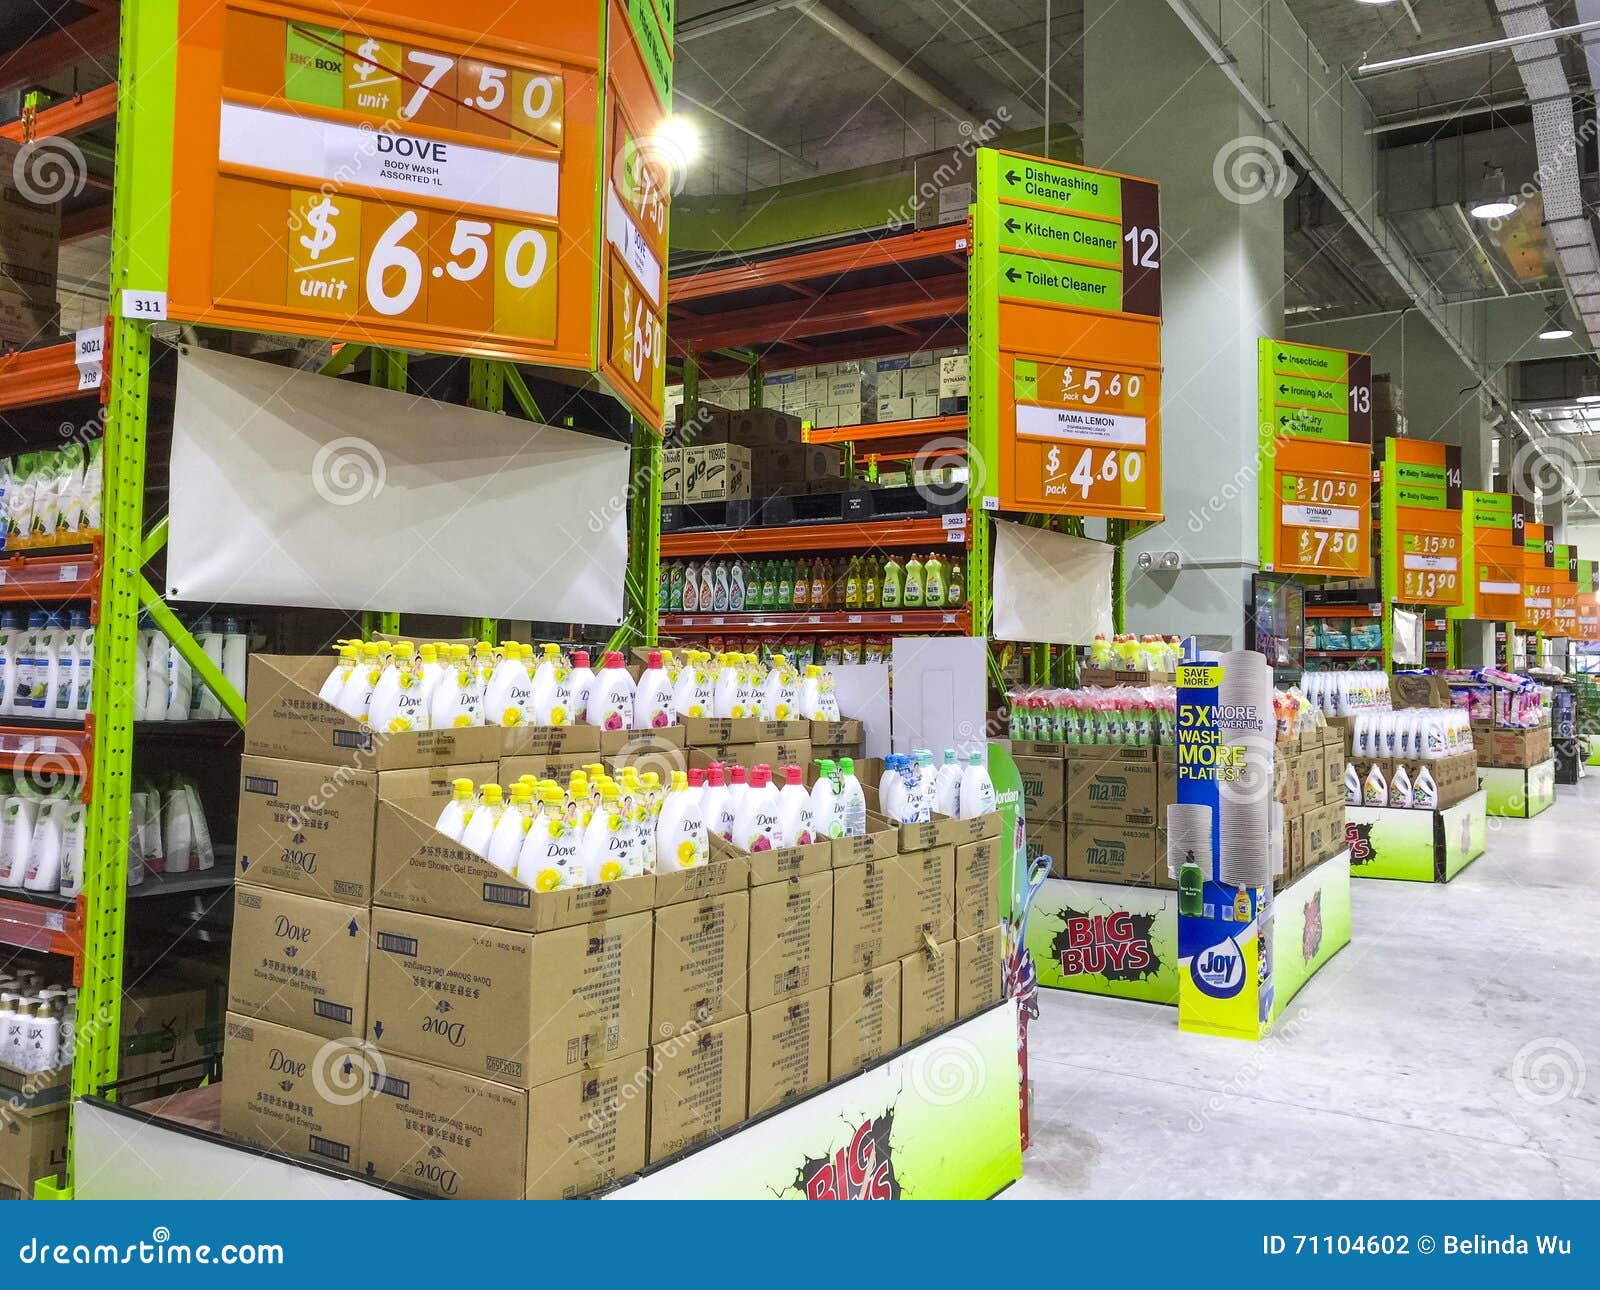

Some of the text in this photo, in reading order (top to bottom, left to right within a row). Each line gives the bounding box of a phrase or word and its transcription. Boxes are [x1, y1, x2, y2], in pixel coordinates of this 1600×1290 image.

[315, 57, 342, 73] BOX
[358, 90, 390, 110] unit
[376, 133, 448, 164] DOVE
[384, 159, 440, 176] BODY WASH
[380, 169, 443, 186] ASSORTED 1L
[1025, 167, 1098, 196] Dishwashing
[1025, 183, 1071, 202] Cleaner
[1025, 222, 1117, 249] Kitchen Cleaner
[1124, 225, 1160, 269] 12
[299, 276, 349, 302] unit
[1026, 271, 1107, 294] Toilet Cleaner
[135, 299, 161, 312] 311
[81, 340, 101, 355] 9021
[1289, 355, 1328, 368] Insecticide
[84, 371, 97, 384] 108
[943, 376, 967, 384] DYNAMO
[1063, 392, 1079, 401] pack
[1291, 386, 1333, 399] Ironing Aids
[1349, 385, 1370, 413] 13
[1058, 414, 1115, 427] MAMA LEMON
[1446, 468, 1462, 489] 14
[1045, 483, 1067, 496] pack
[1306, 507, 1332, 516] DYNAMO
[1512, 513, 1524, 529] 15
[1544, 540, 1554, 553] 16
[1569, 558, 1577, 570] 17
[1184, 669, 1208, 677] SAVE
[460, 694, 480, 705] Dove
[511, 687, 531, 699] Dove
[399, 695, 422, 708] Dove
[1179, 705, 1257, 727] 5X MORE
[1179, 730, 1222, 744] WASH
[1179, 745, 1247, 767] MORE
[684, 819, 702, 832] Dove
[756, 814, 778, 826] Dove
[547, 844, 576, 857] Dove
[609, 837, 635, 850] Dove
[281, 849, 317, 874] Dove
[410, 858, 498, 879] Dove Shower Gel Energize
[275, 915, 311, 942] Dove
[1067, 911, 1135, 949] BIG
[1060, 940, 1150, 977] BUYS
[403, 961, 431, 975] Energize
[446, 969, 472, 982] Shower
[1200, 952, 1237, 983] Joy
[473, 975, 491, 987] Dove
[422, 1016, 466, 1047] Dove
[269, 1048, 306, 1078] Dove
[395, 1103, 482, 1137] Dove Shower Gel Energize
[806, 1117, 876, 1200] BIG
[414, 1160, 457, 1195] Dove
